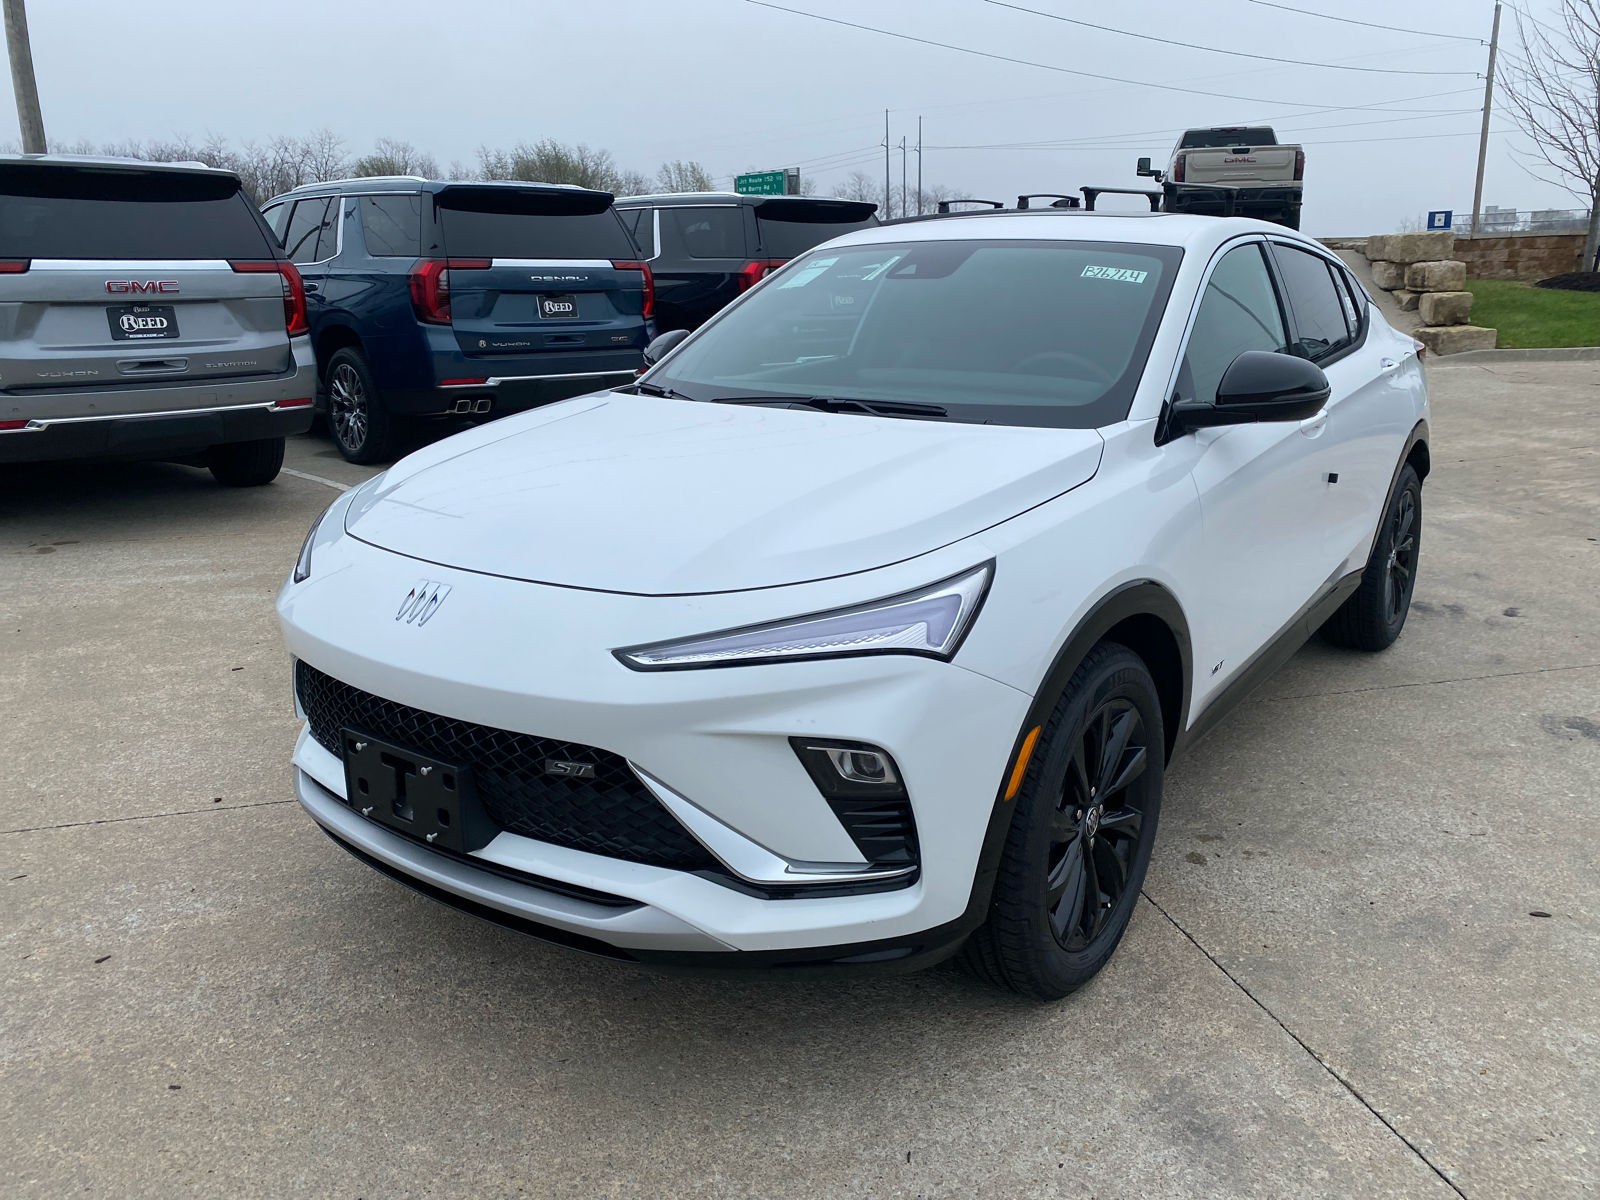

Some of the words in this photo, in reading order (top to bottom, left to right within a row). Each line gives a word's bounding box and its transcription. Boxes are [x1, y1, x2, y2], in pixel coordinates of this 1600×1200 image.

[1224, 155, 1257, 163] GMC
[105, 280, 179, 293] GMC
[543, 300, 573, 314] REED
[120, 314, 168, 332] REED
[36, 370, 99, 378] YUKON
[549, 761, 592, 776] ST
